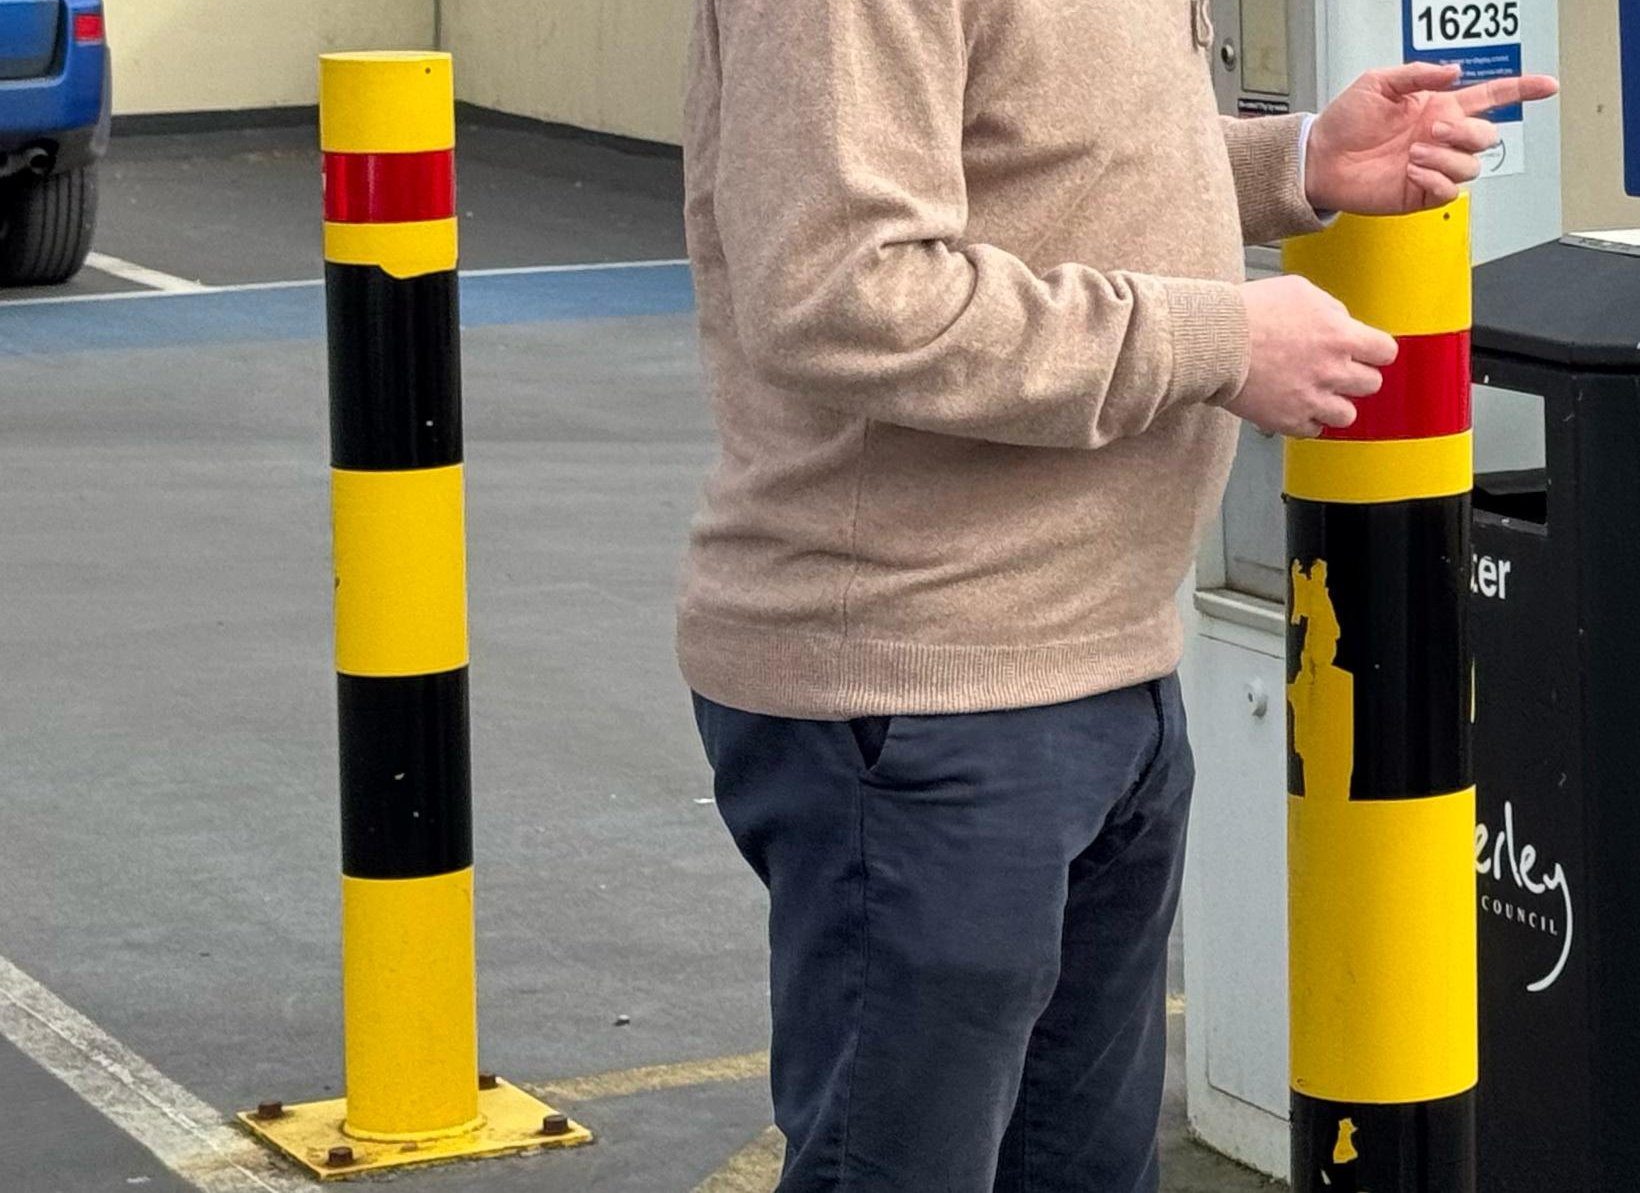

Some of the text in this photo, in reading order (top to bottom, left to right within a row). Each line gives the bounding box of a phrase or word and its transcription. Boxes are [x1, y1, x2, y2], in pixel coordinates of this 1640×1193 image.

[1418, 1, 1519, 42] 16235
[1475, 801, 1573, 992] erley
[1481, 894, 1558, 936] COUNCIL
